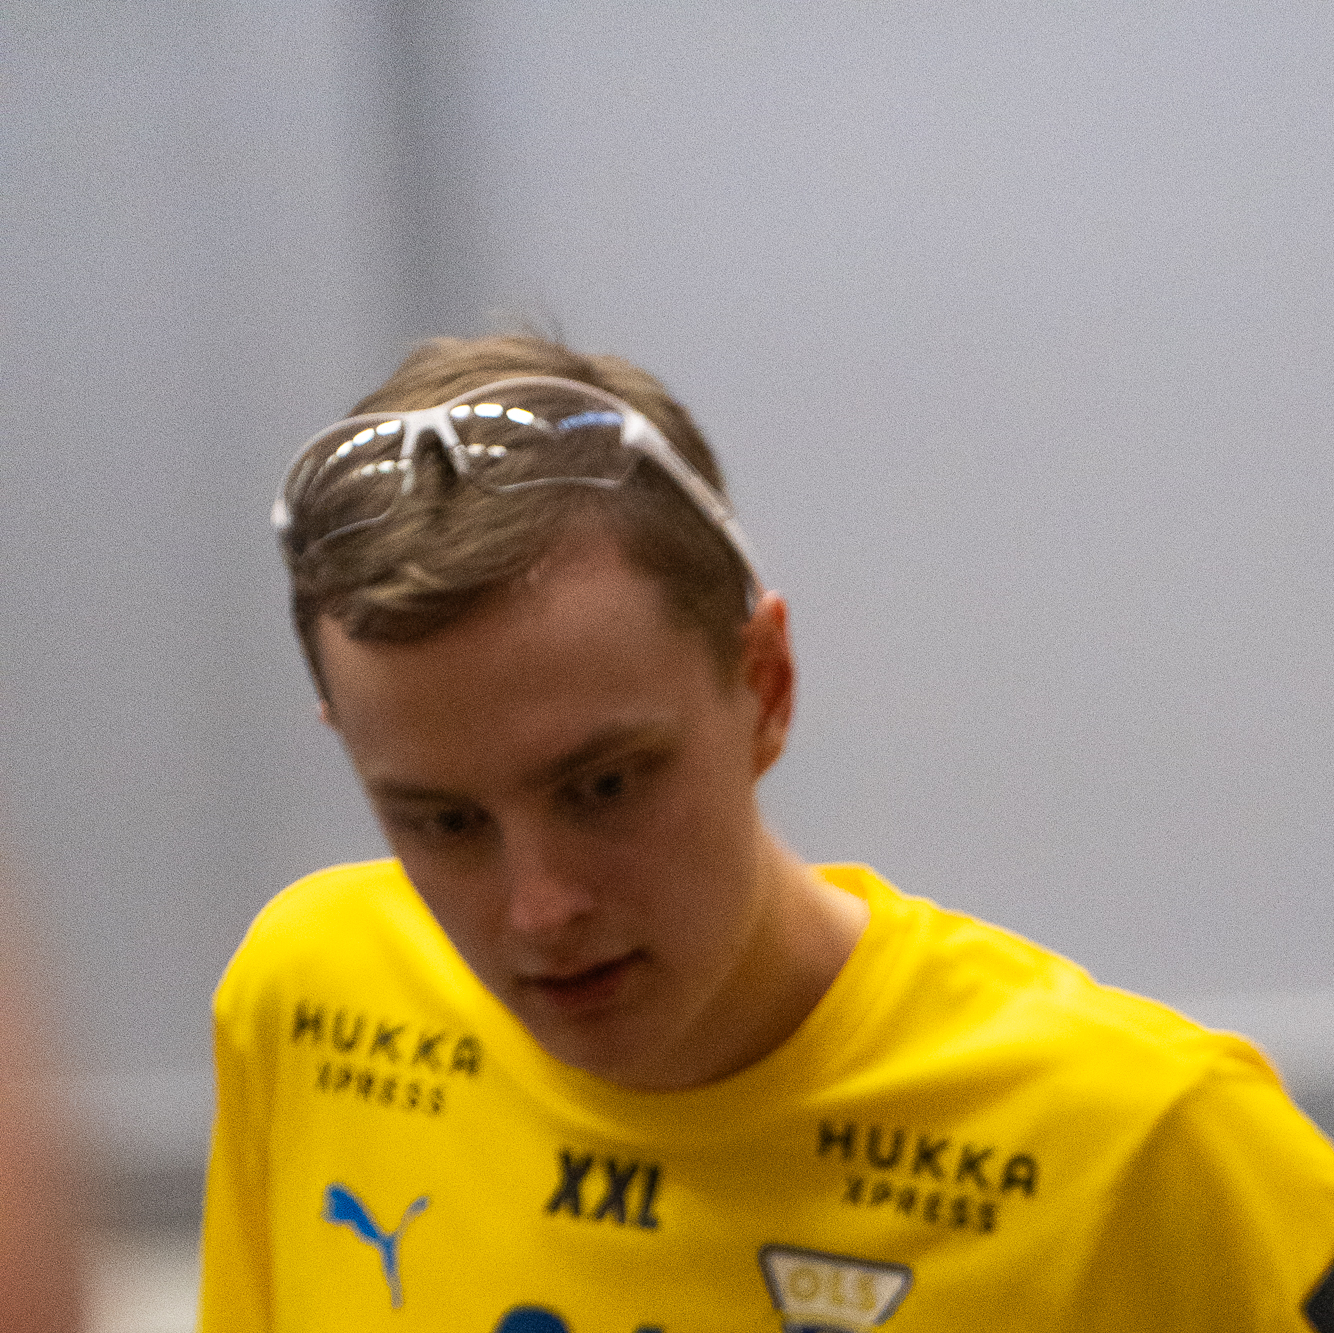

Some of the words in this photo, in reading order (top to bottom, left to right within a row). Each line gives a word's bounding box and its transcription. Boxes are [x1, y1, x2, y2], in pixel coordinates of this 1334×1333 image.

[291, 1001, 483, 1076] HUKKA
[546, 1148, 662, 1230] XXL
[817, 1118, 1038, 1197] HUKKA
